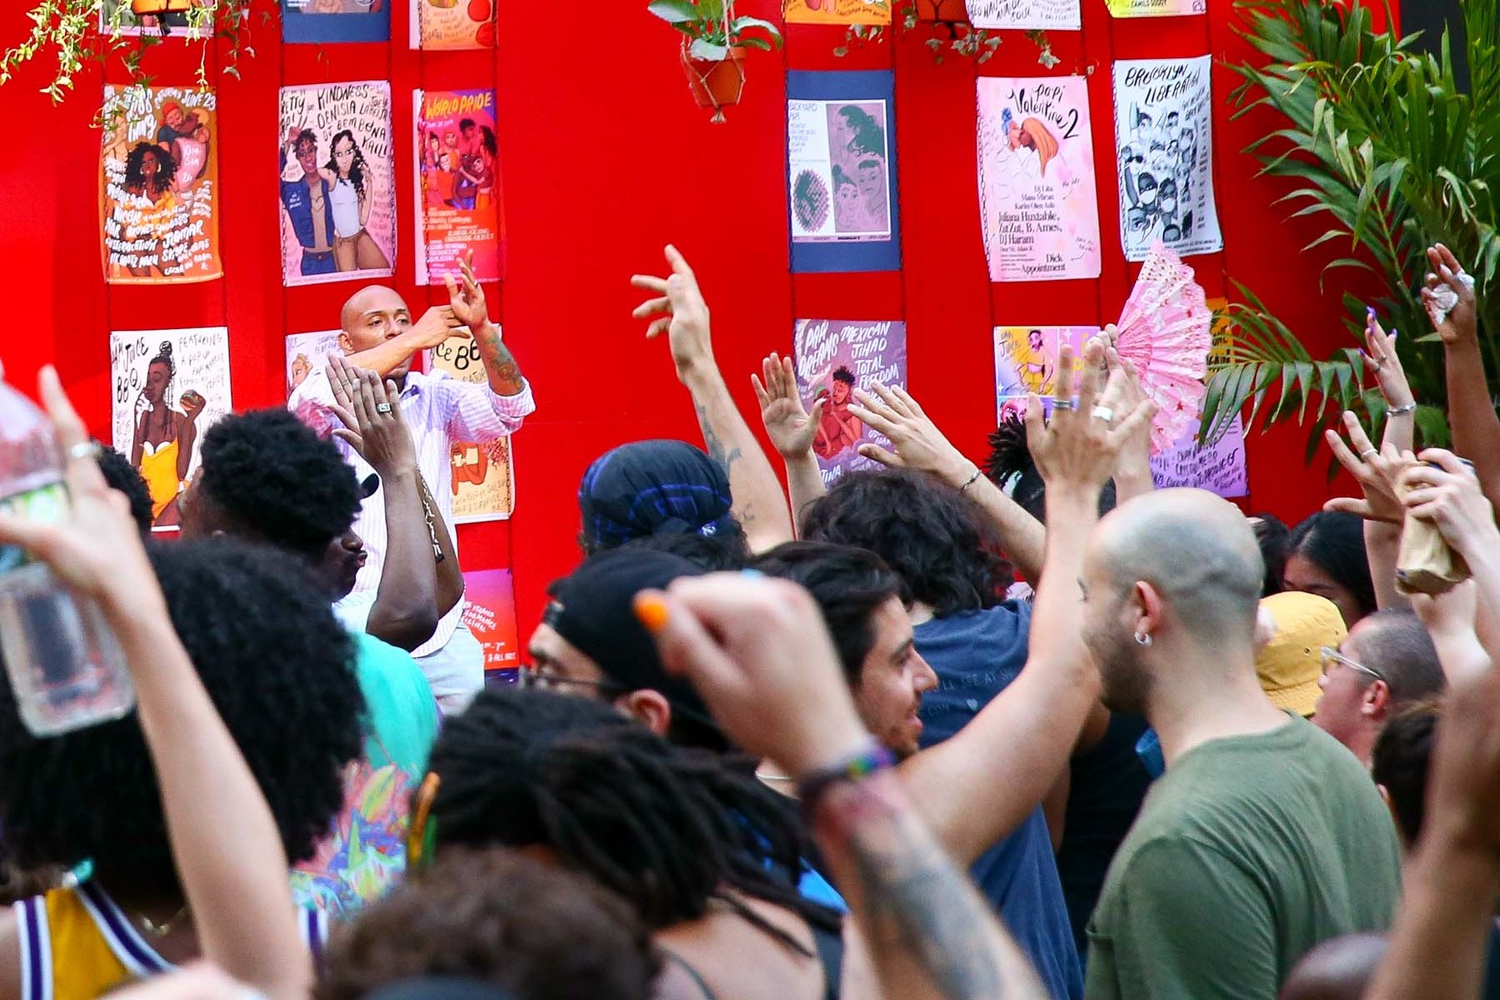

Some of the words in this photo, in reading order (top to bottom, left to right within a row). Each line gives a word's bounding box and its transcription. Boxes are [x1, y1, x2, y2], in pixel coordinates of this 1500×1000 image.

[1124, 64, 1189, 88] BROOKLYN
[181, 88, 205, 107] JUNE
[316, 83, 370, 111] KINDNESS
[1033, 83, 1066, 103] papi
[317, 100, 357, 130] DENISIA
[425, 95, 459, 120] WORLD
[459, 91, 493, 115] PRIDE
[1007, 88, 1069, 130] Valentine
[1062, 108, 1080, 140] 2
[336, 116, 387, 141] BEMBONA
[361, 136, 389, 160] KAILI
[1008, 233, 1035, 245] Haram
[1036, 222, 1063, 233] Ames,
[1021, 264, 1067, 275] Appointment
[1045, 253, 1063, 263] Dick
[804, 319, 829, 356] PAPI
[840, 321, 891, 344] MEXICAN
[122, 336, 150, 373] JUICE
[798, 332, 840, 380] DREAMS
[851, 337, 888, 360] JIHAD
[855, 354, 886, 376] TOTAL
[859, 362, 900, 393] FREEDOM
